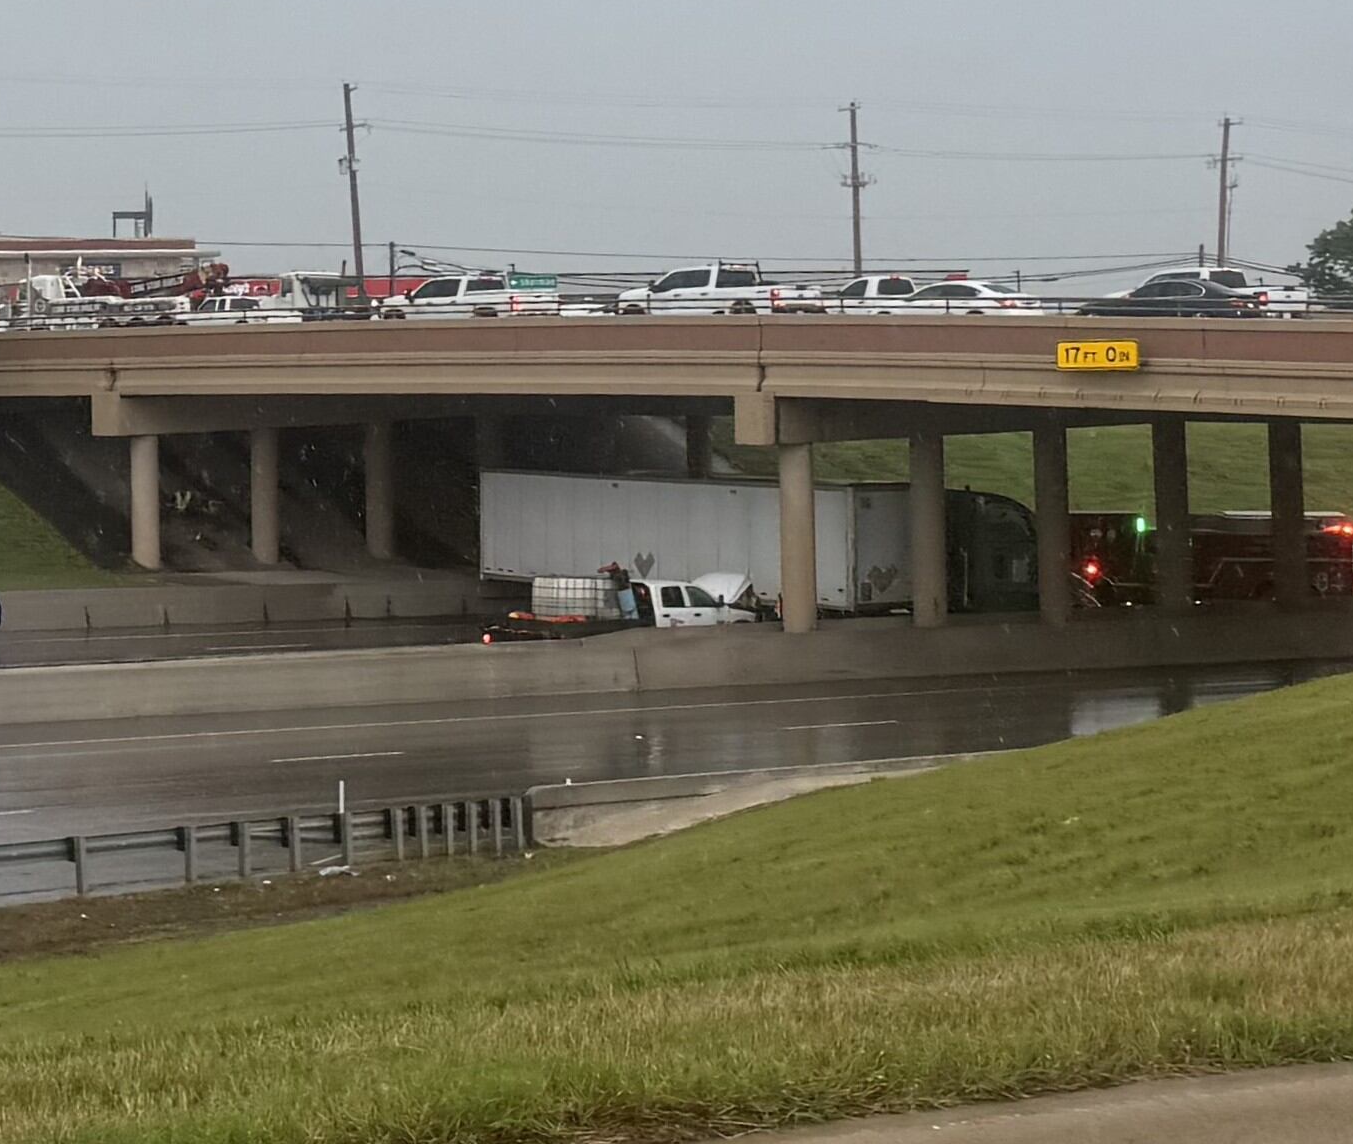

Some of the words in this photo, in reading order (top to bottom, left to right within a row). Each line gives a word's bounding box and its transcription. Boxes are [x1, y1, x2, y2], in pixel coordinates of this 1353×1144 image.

[1065, 347, 1080, 363] 17
[1084, 352, 1096, 362] FT
[1106, 346, 1116, 362] 0
